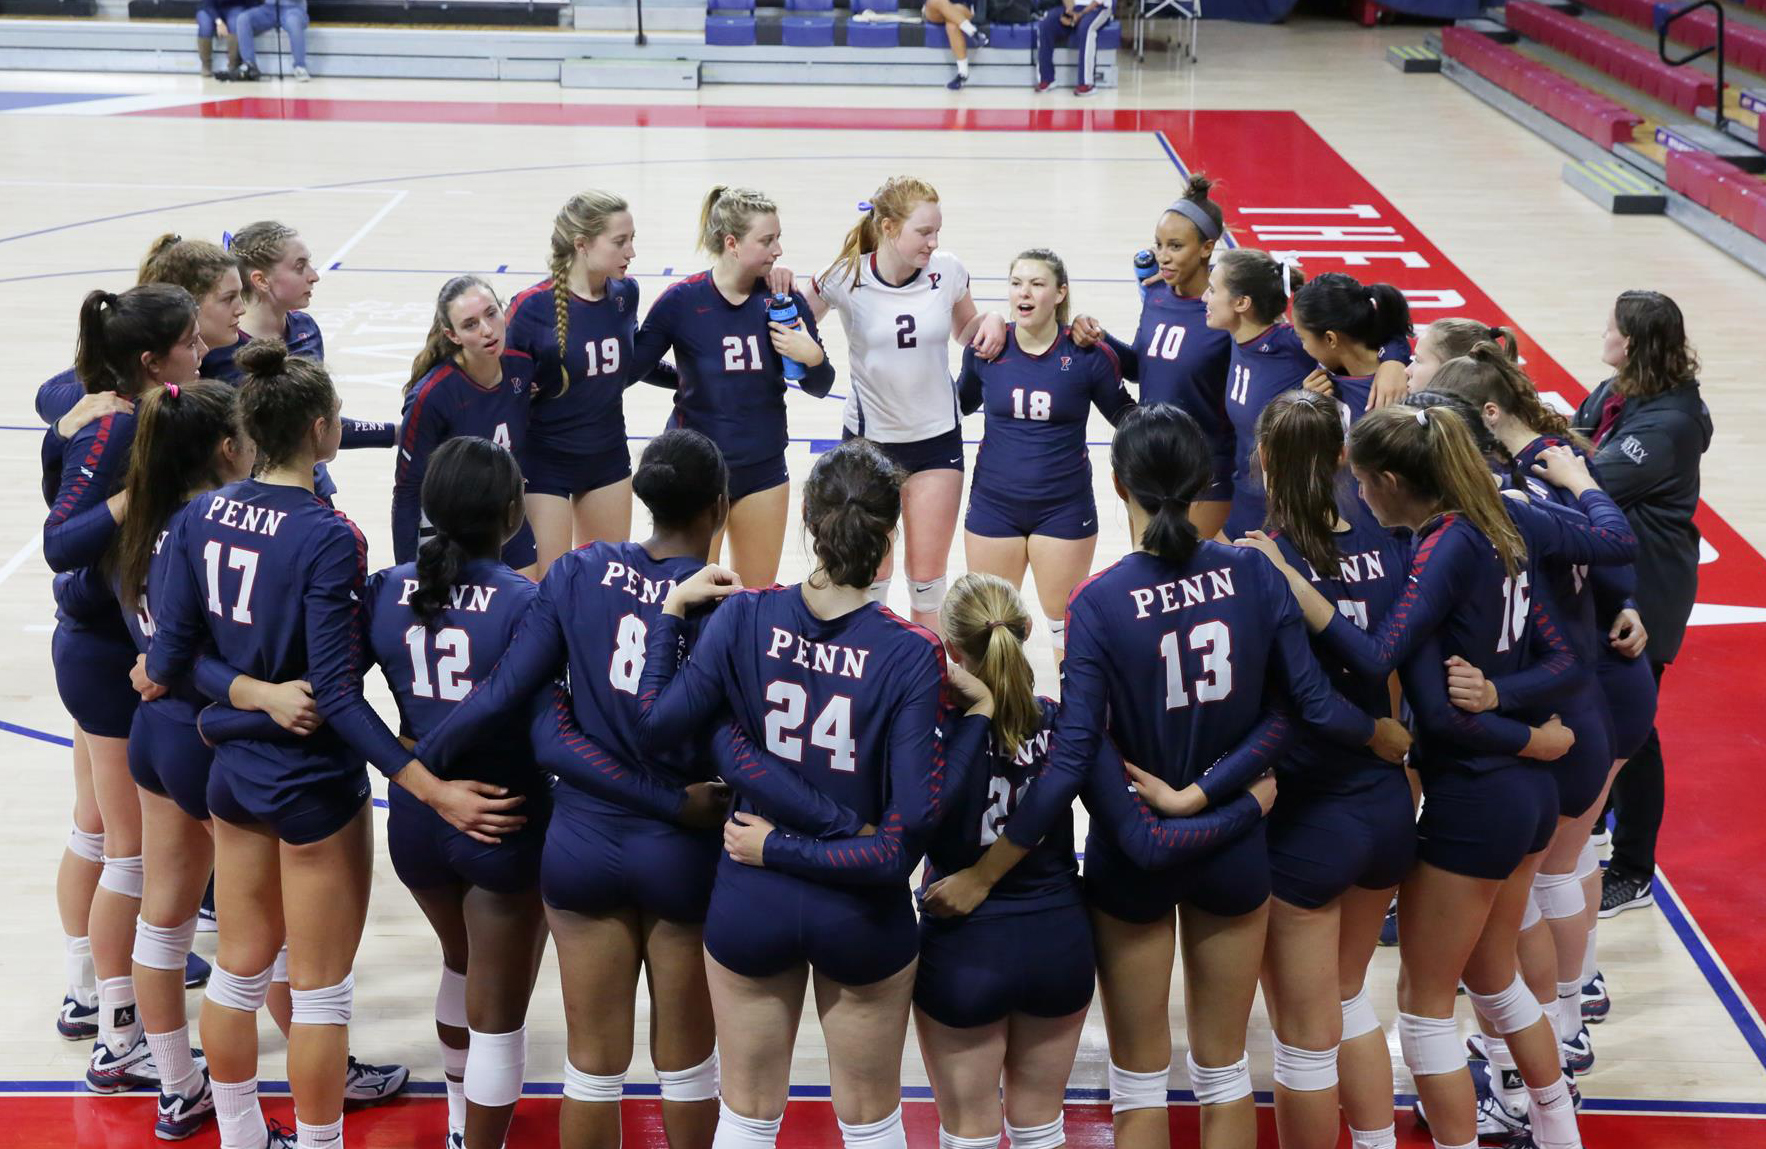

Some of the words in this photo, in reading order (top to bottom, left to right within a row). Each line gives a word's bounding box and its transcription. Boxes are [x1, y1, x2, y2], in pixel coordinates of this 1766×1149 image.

[1238, 204, 1430, 268] THE
[895, 314, 917, 349] 2
[1147, 323, 1186, 360] 10
[586, 338, 620, 377] 19
[723, 335, 763, 371] 21
[1012, 388, 1052, 421] 18
[1230, 364, 1250, 405] 11
[354, 421, 386, 432] PENN
[492, 422, 512, 452] 4
[205, 495, 288, 537] PENN
[203, 540, 260, 624] 17
[1303, 550, 1385, 583] NN
[397, 579, 498, 612] PNN
[1129, 567, 1236, 619] PENN
[405, 625, 474, 702] 12
[609, 613, 648, 696] 8
[766, 627, 870, 679] PENN
[1160, 620, 1232, 711] 13
[764, 680, 857, 772] 24
[980, 775, 1037, 847] 2
